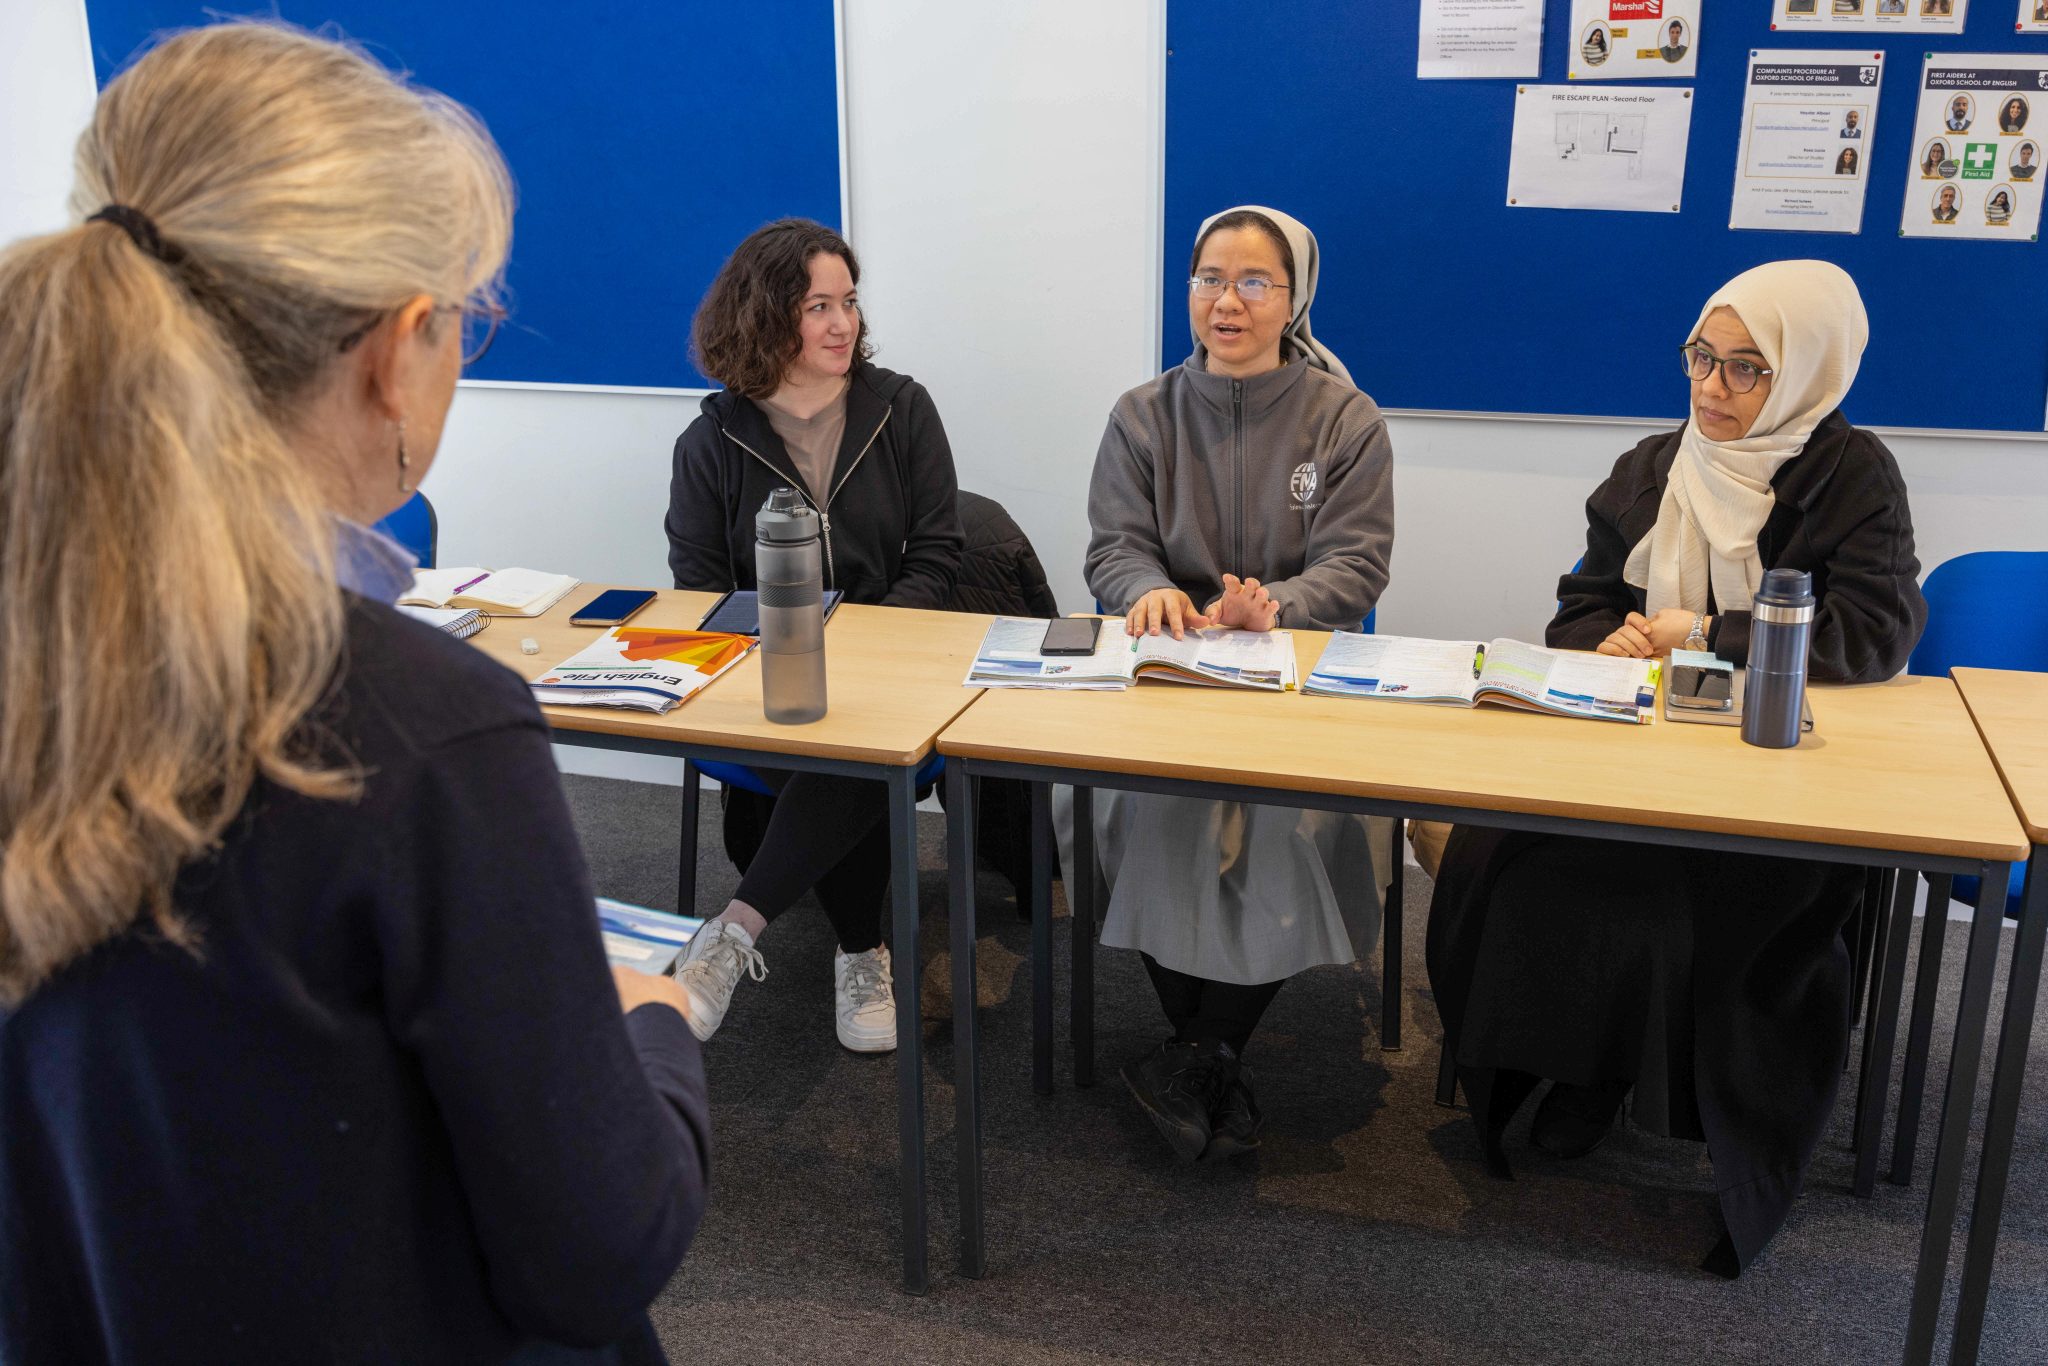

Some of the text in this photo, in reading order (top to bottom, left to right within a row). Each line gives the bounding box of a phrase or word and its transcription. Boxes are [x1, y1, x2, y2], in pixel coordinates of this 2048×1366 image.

[1612, 2, 1645, 11] Marshal
[562, 673, 602, 681] File
[604, 672, 683, 686] English
